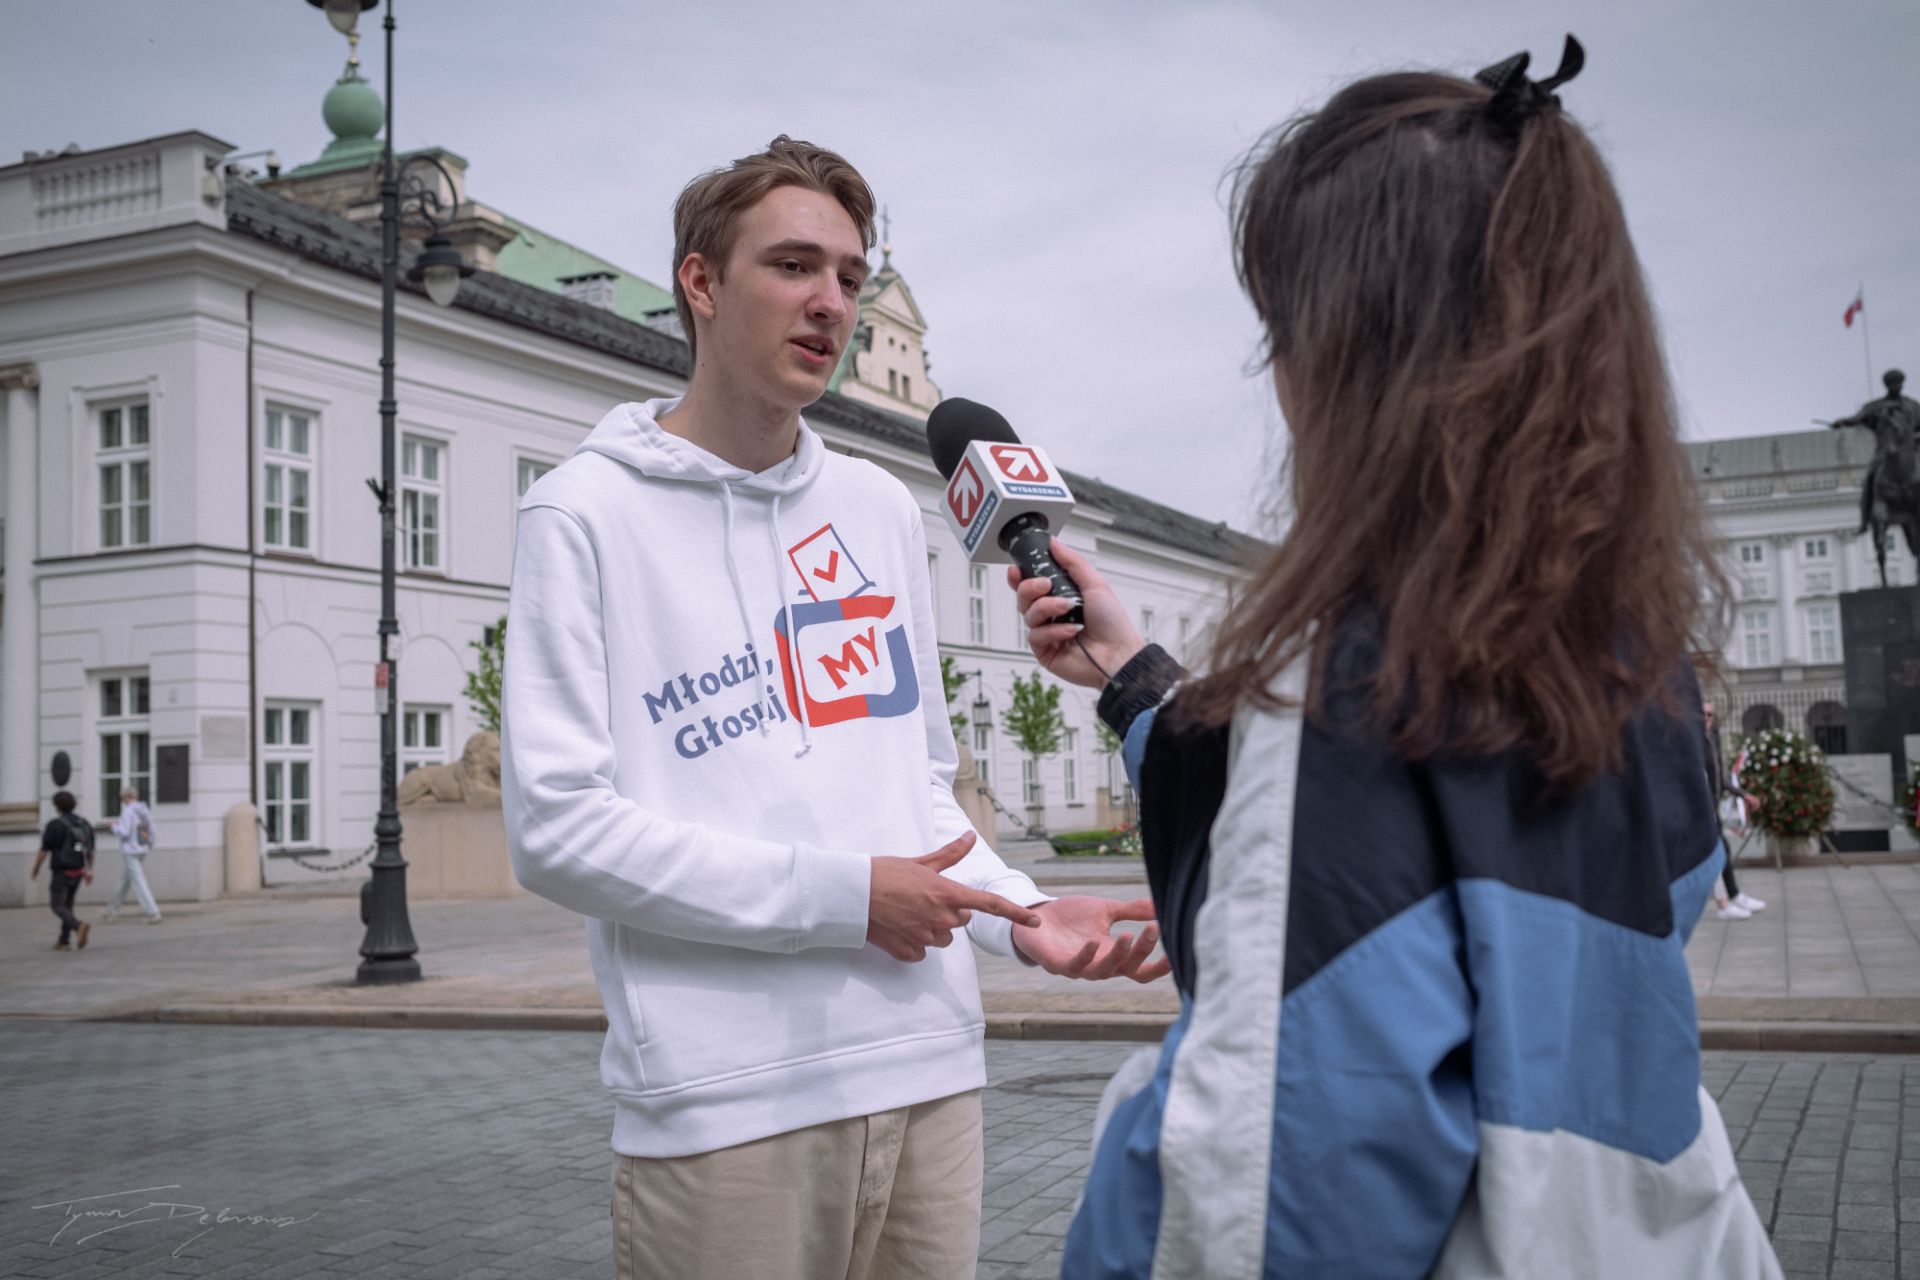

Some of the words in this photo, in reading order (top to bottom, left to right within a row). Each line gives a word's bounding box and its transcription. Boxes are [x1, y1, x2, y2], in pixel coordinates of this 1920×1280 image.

[1008, 485, 1063, 497] WYDARZENIA
[641, 642, 774, 725] Młodzi,
[817, 625, 880, 690] MY
